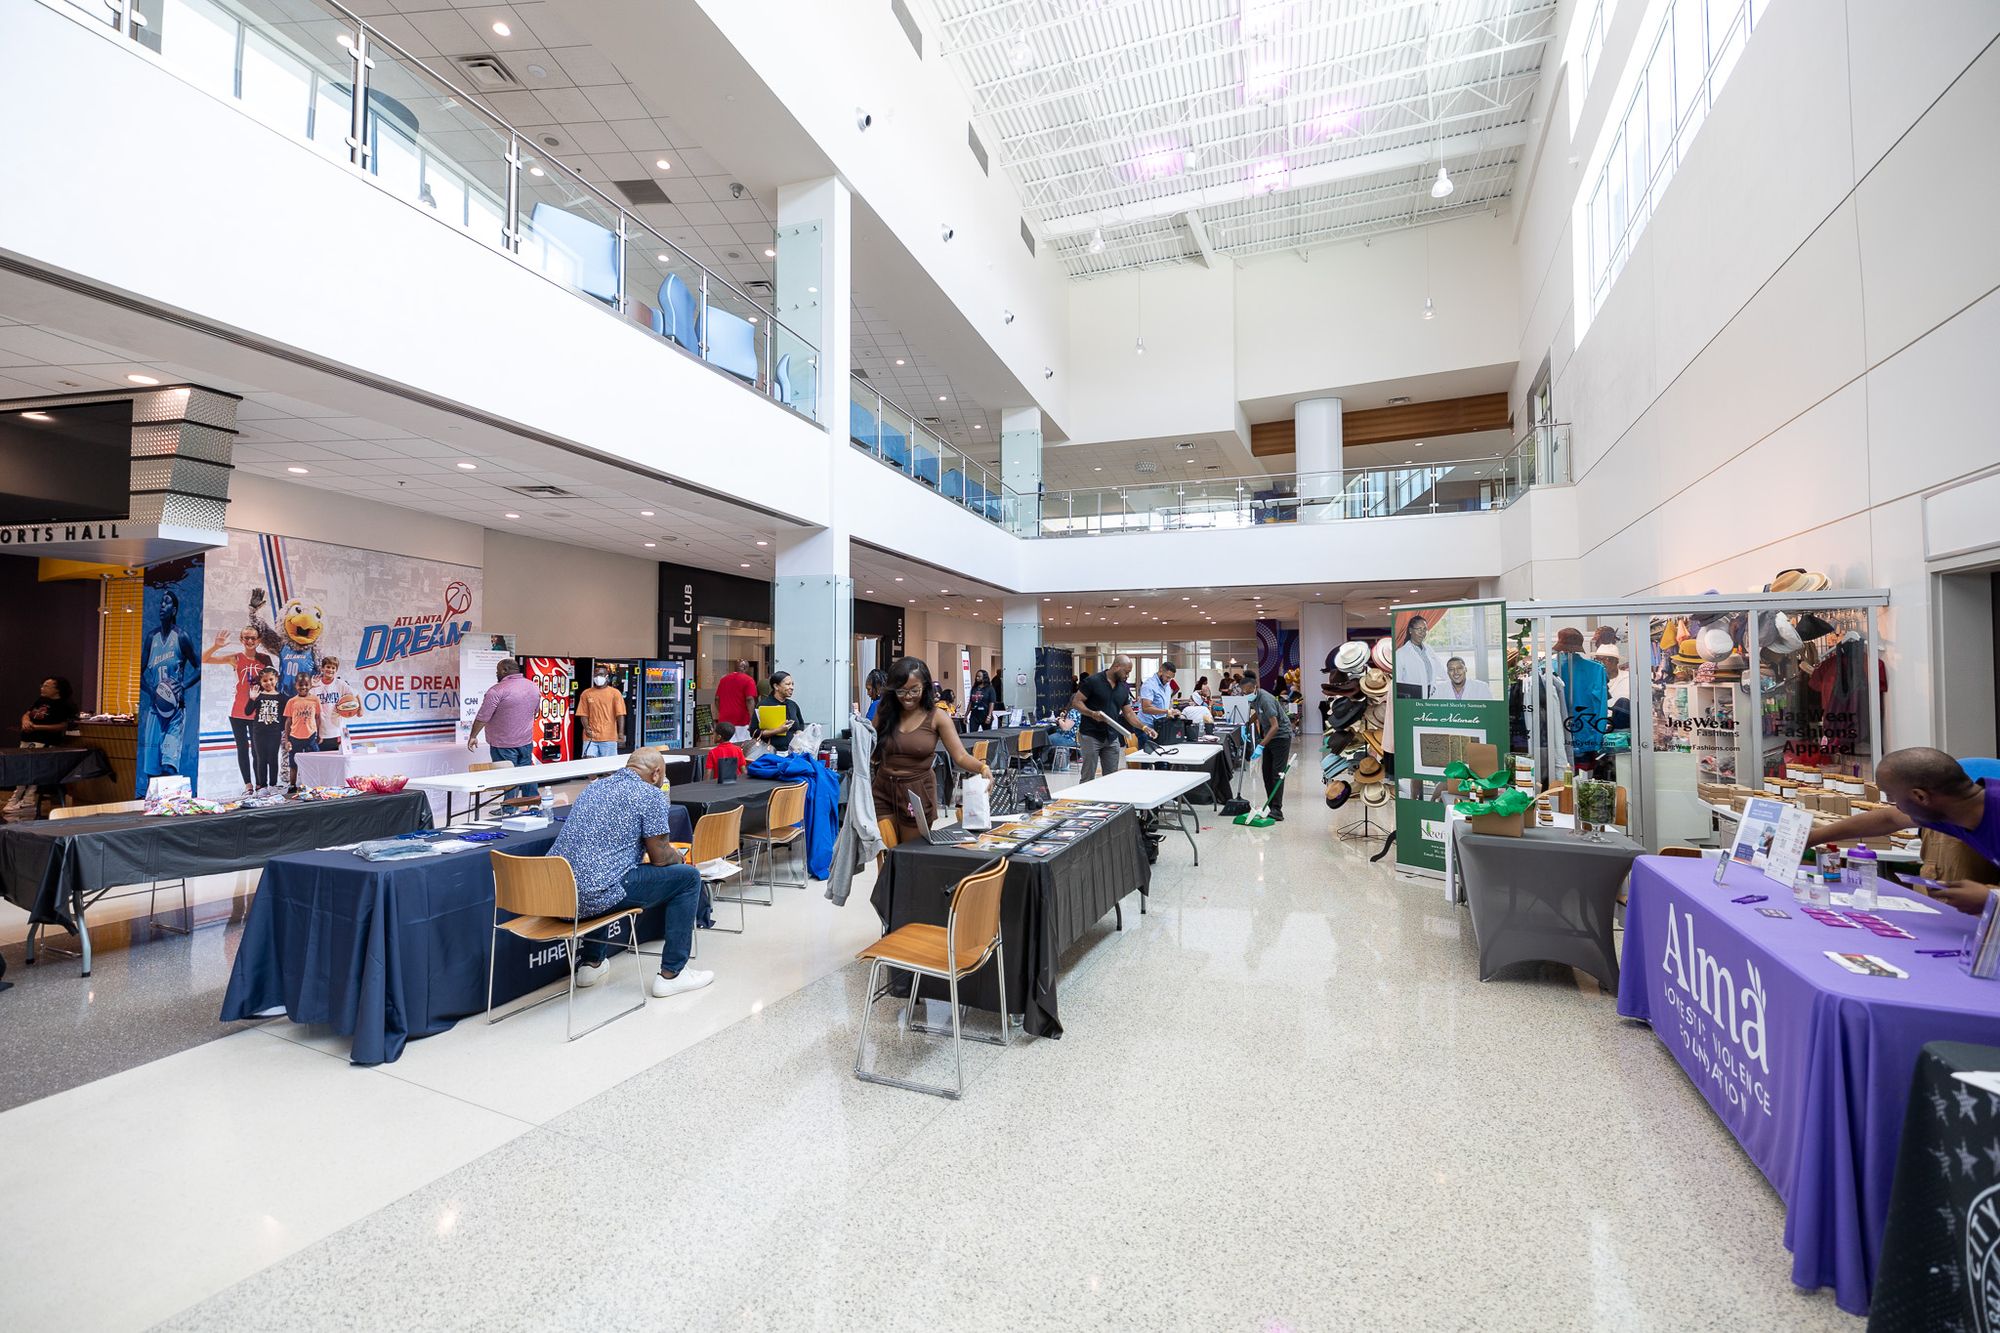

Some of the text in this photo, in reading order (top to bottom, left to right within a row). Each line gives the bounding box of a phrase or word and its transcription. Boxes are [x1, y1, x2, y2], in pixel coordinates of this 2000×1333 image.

[0, 524, 119, 544] ORTS HALL
[684, 584, 693, 624] CLUB
[394, 614, 442, 627] ATLANTA
[668, 616, 692, 660] IT
[286, 661, 299, 677] 00
[364, 675, 461, 691] ONE DREA
[364, 692, 410, 711] ONE
[464, 697, 479, 705] CNN
[1664, 715, 1740, 732] JagWear
[1774, 724, 1858, 739] Fashions
[1696, 729, 1740, 738] Fashions
[1666, 744, 1741, 752] JagWearFashions.com
[1783, 740, 1856, 757] Apparel
[1662, 902, 1769, 1075] Alma
[1712, 1032, 1772, 1117] VIOLENCE
